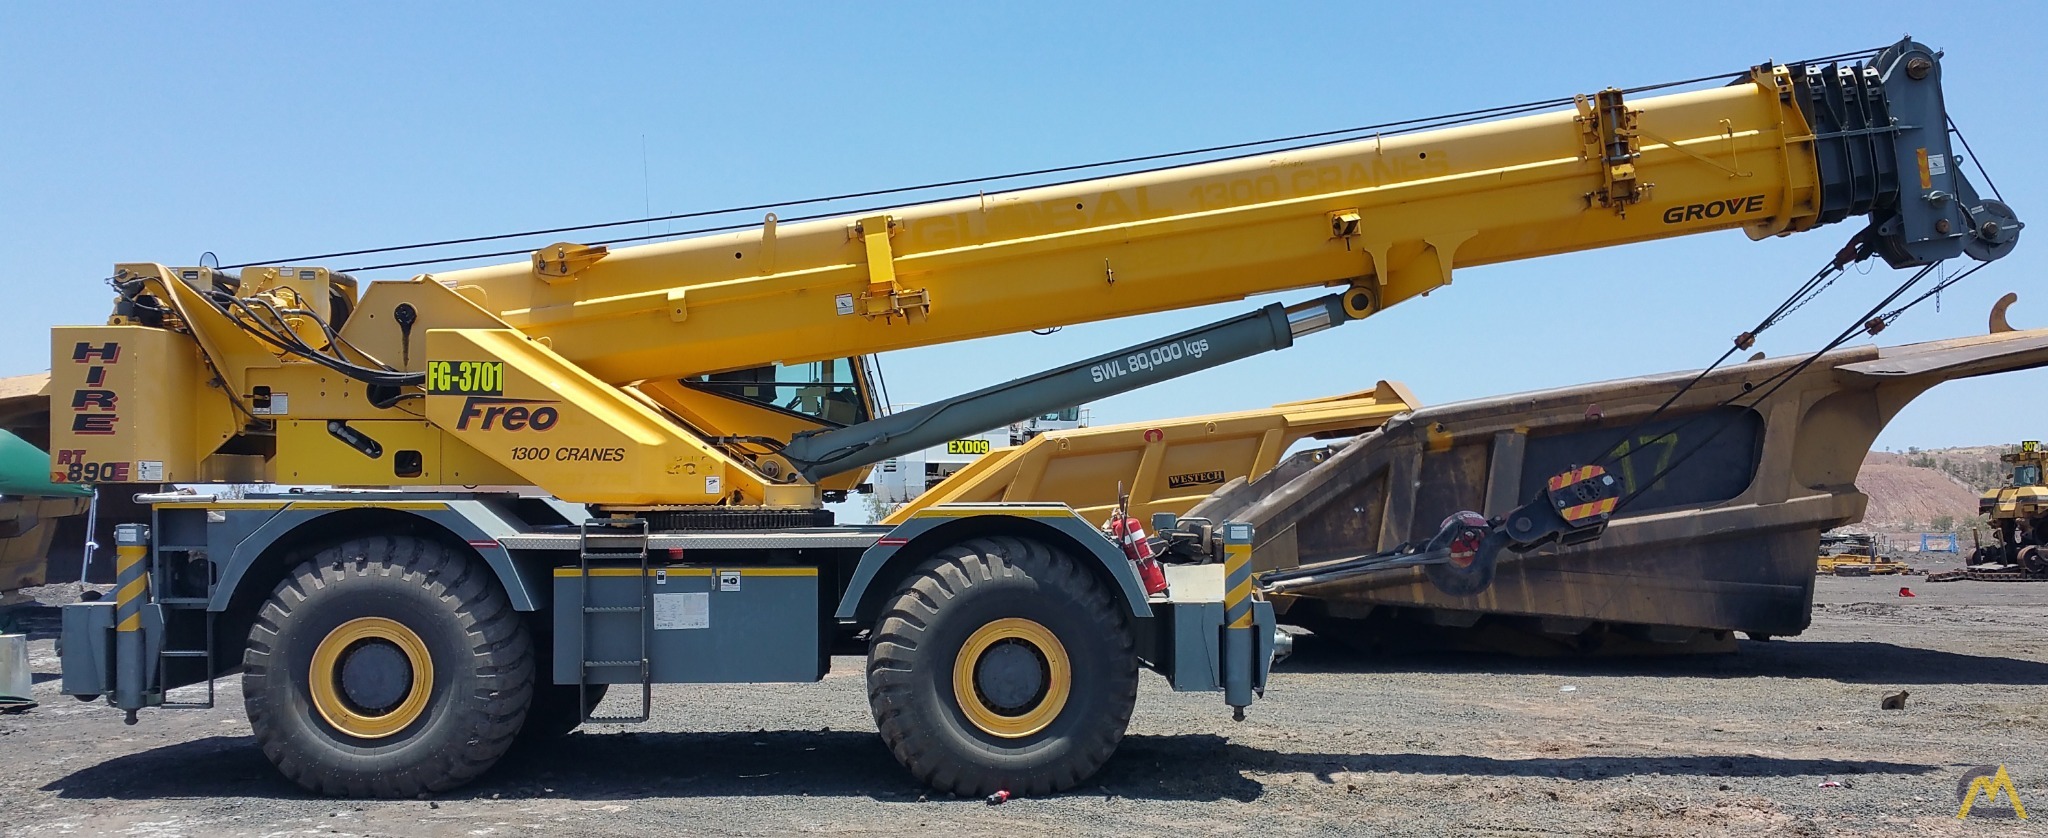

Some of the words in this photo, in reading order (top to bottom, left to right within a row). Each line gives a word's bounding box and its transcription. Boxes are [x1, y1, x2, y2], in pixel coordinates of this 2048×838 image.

[1663, 194, 1765, 224] GROVE
[1090, 361, 1127, 383] SWL
[1127, 342, 1183, 373] 80,000
[1182, 338, 1209, 359] kgs
[71, 342, 121, 436] HIRE
[428, 361, 503, 392] FG-3701
[456, 397, 562, 432] Freo
[57, 449, 87, 465] RT
[511, 447, 549, 461] 1300
[555, 447, 625, 462] CRANES
[948, 440, 989, 454] EXD09
[67, 462, 130, 483] 890E
[1169, 470, 1223, 485] WESTECH
